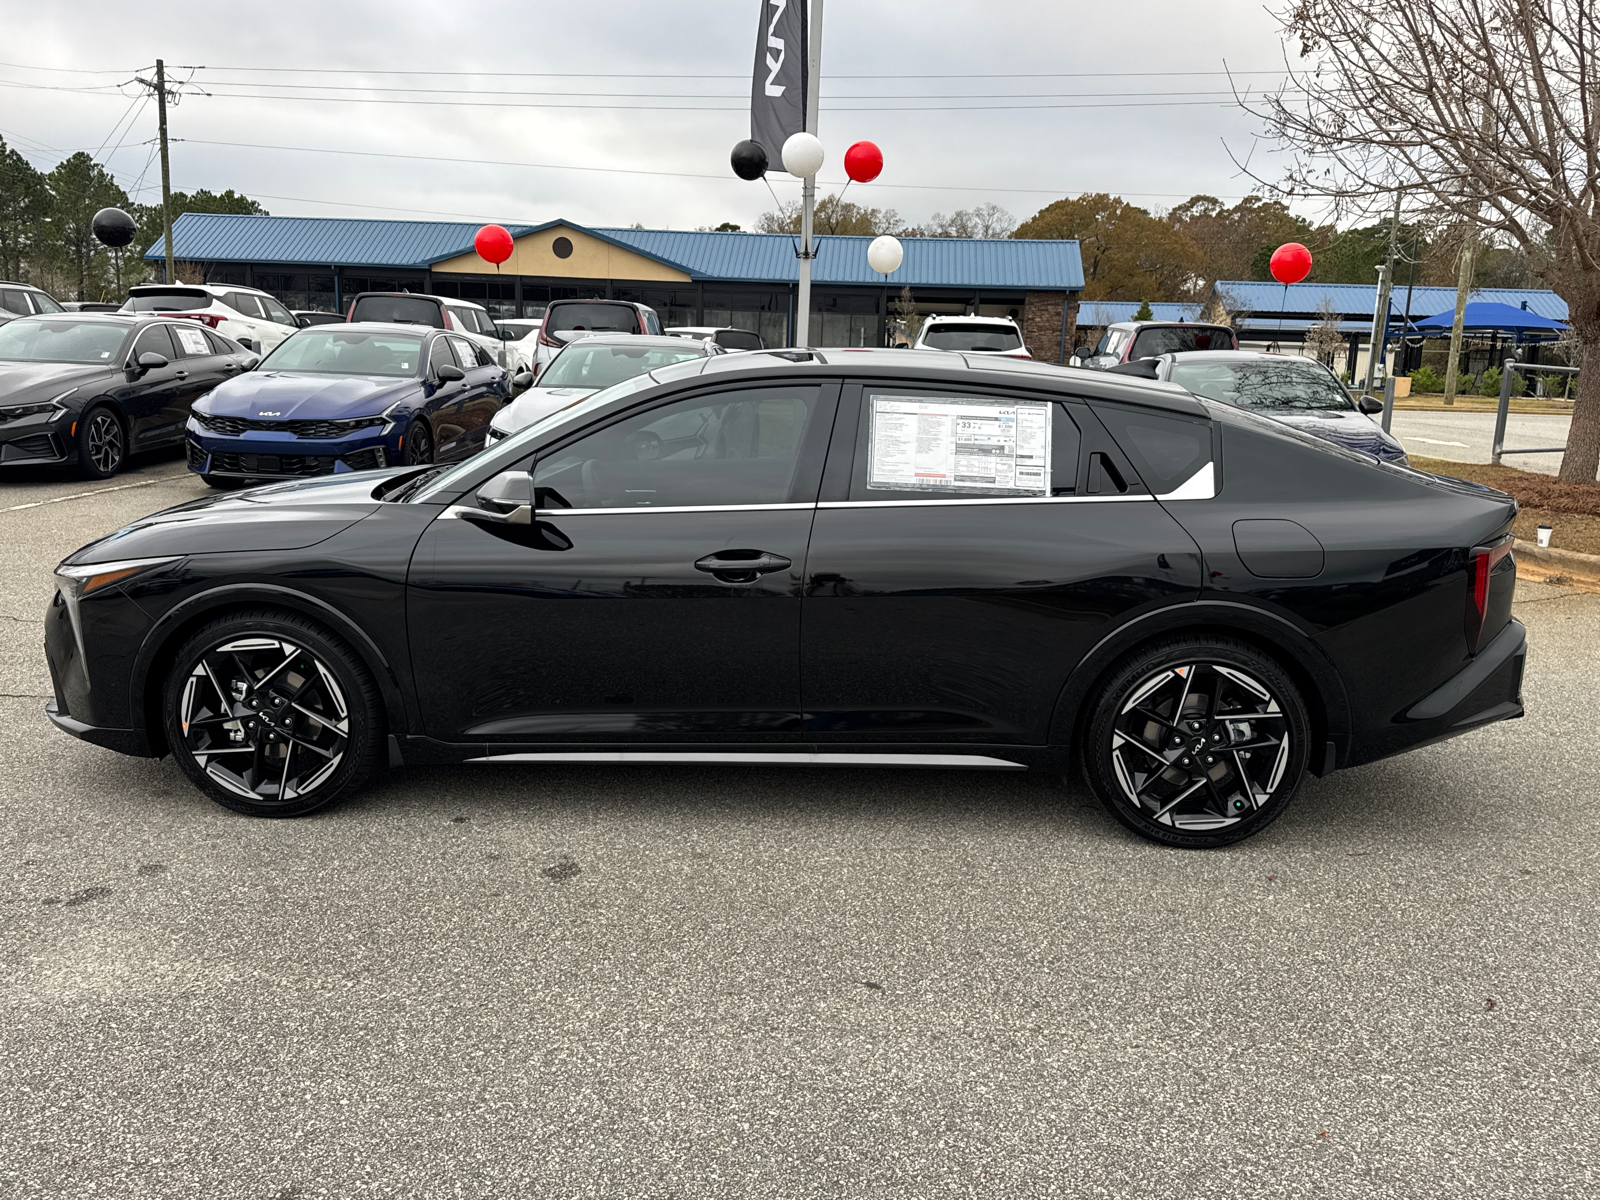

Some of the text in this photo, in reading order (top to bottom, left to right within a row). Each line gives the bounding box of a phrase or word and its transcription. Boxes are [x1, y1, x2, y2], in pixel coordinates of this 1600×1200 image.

[961, 421, 972, 429] 33
[1113, 662, 1156, 702] KUMHO
[258, 711, 275, 727] KIA
